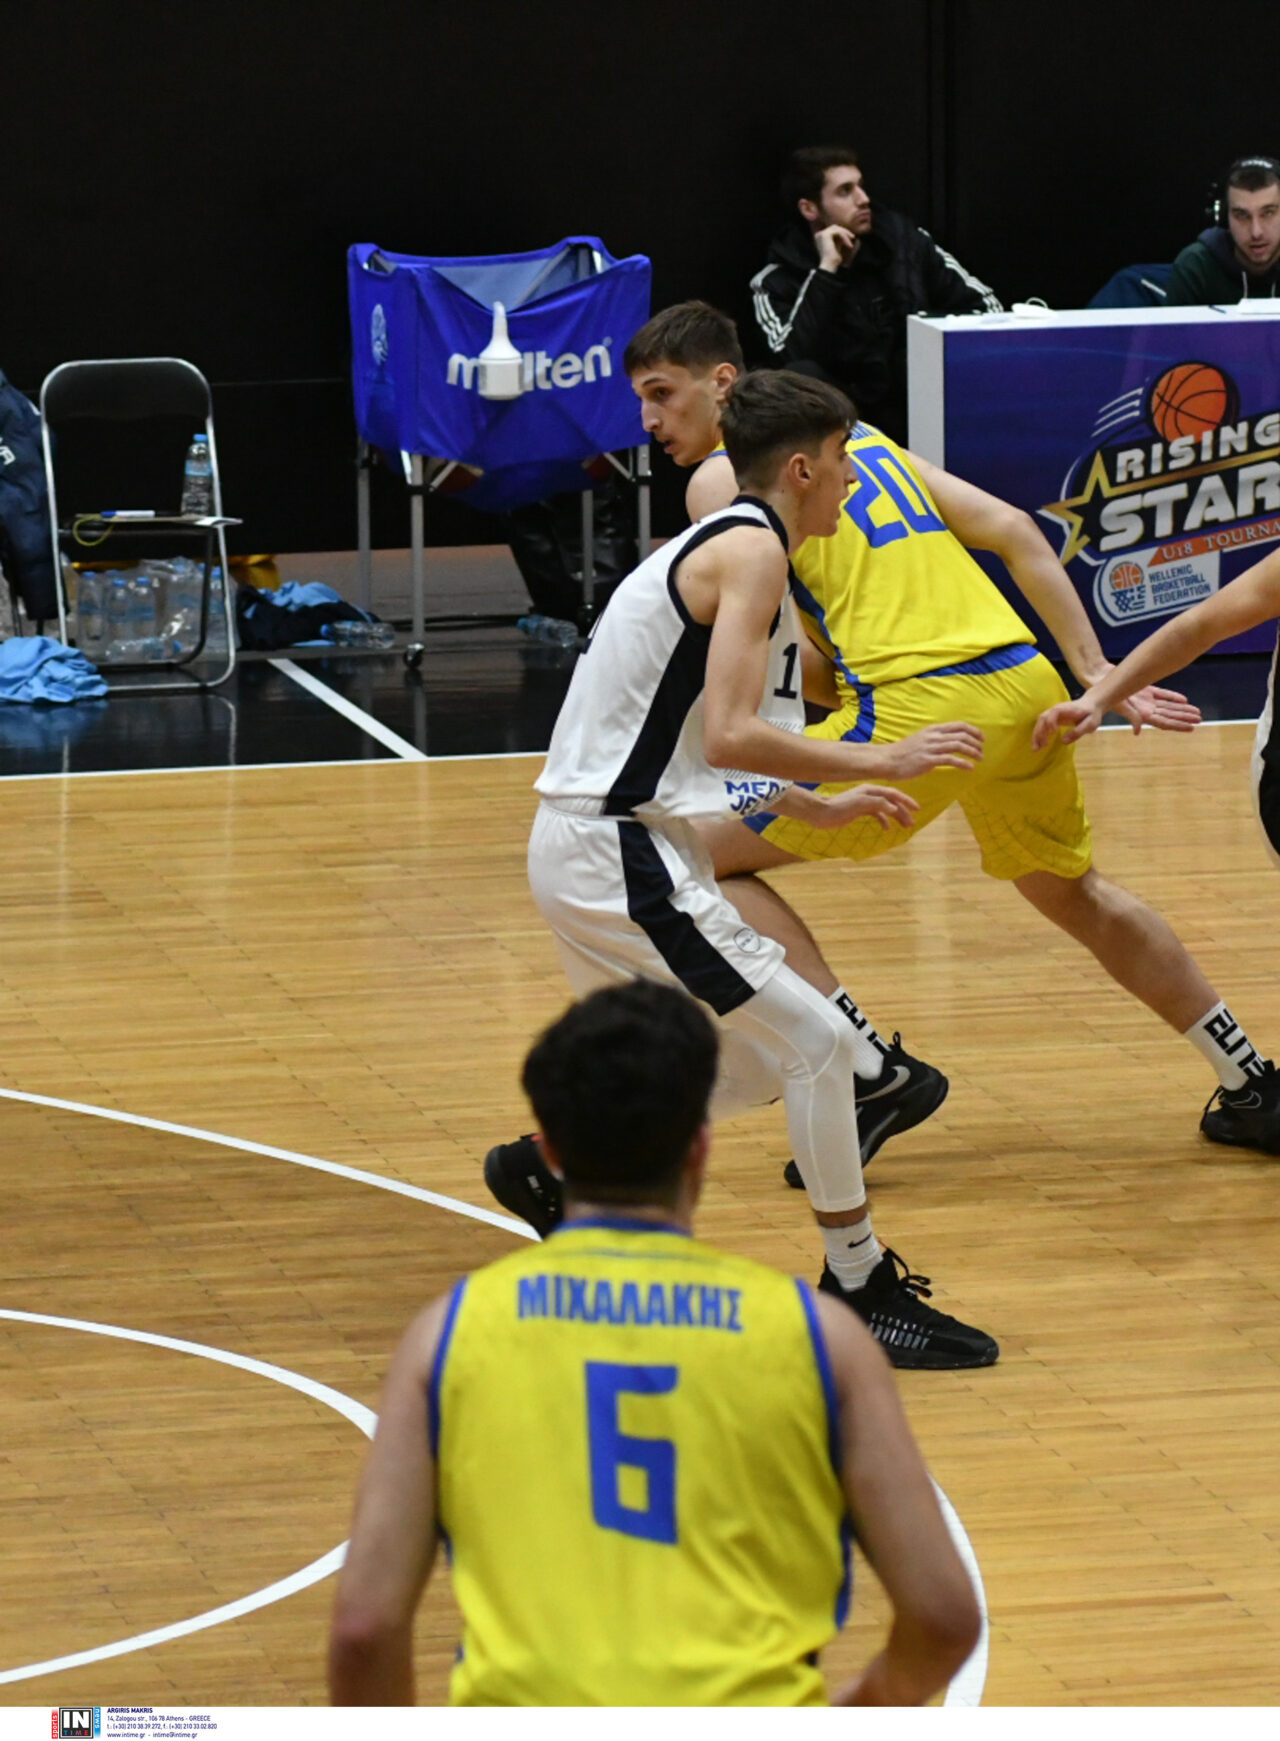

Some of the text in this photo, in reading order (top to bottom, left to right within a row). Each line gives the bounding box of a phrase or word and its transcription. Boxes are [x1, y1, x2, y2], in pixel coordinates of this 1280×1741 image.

[446, 344, 612, 391] mlten
[1116, 413, 1280, 483] RISING
[844, 446, 949, 549] 20
[1162, 542, 1193, 561] U18
[1148, 564, 1193, 583] HELLENIC
[1151, 574, 1205, 594] BASKETBALL
[1153, 583, 1211, 605] FEDERATION
[724, 781, 786, 800] MED
[518, 1274, 742, 1332] ΜΙΧΑΛΑΚΗΣ
[585, 1361, 678, 1545] 6
